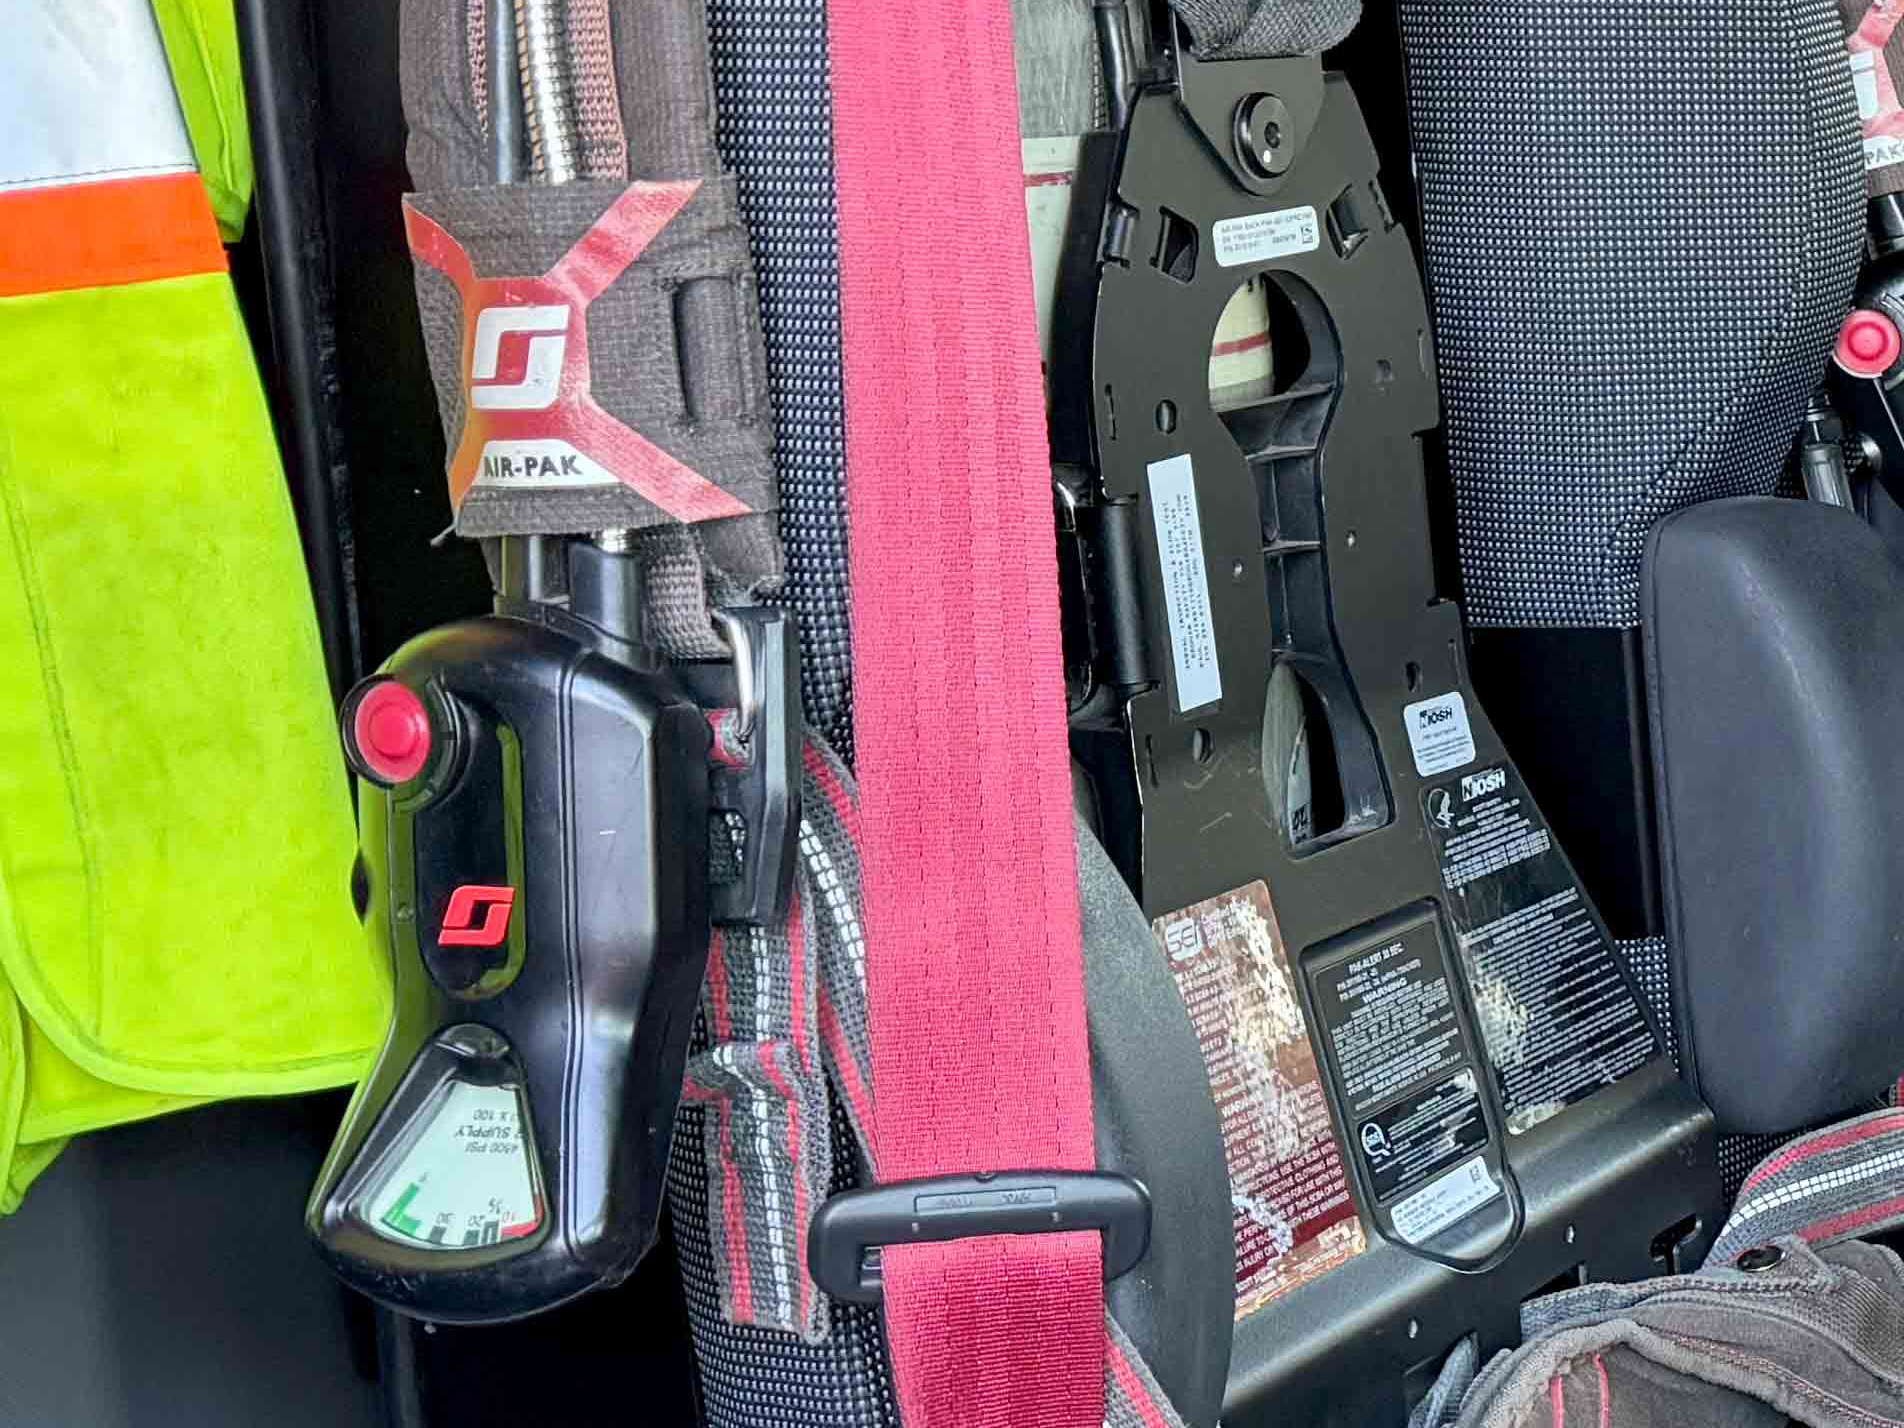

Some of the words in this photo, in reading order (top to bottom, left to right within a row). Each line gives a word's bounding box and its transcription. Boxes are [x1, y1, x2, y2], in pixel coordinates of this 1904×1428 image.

[484, 454, 584, 478] AIR-PAK
[1461, 769, 1506, 802] NIOSH
[454, 1126, 511, 1139] SUPPLY
